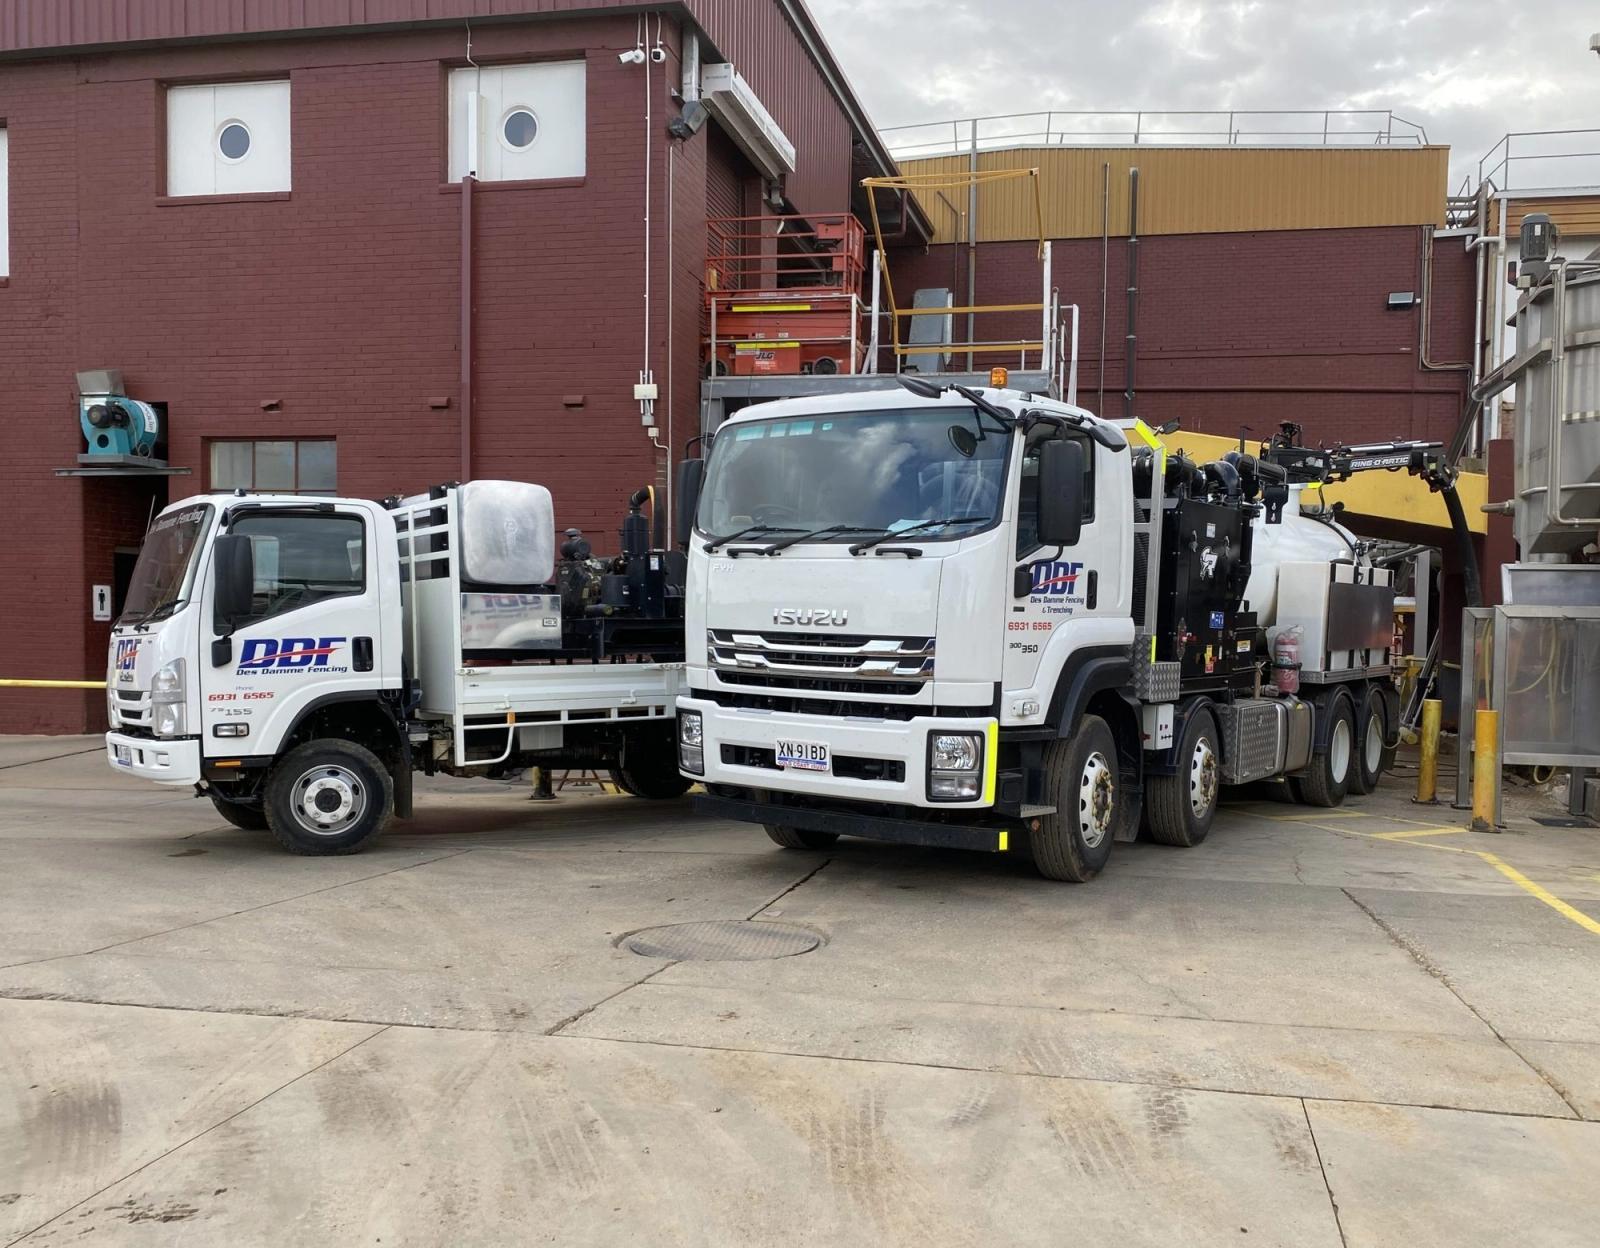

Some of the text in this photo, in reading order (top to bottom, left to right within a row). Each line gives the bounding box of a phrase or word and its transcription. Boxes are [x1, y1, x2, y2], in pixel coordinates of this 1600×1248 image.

[1030, 561, 1083, 595] DDF
[1030, 596, 1085, 605] Des Damme Fencing
[1047, 606, 1073, 615] Trenching
[773, 608, 848, 627] ISUZU
[1008, 622, 1052, 631] 6931 6565
[116, 638, 142, 670] DDF
[238, 637, 347, 669] DDF
[236, 668, 258, 676] Des
[261, 667, 304, 675] Damme
[208, 691, 275, 702] 6931 6565
